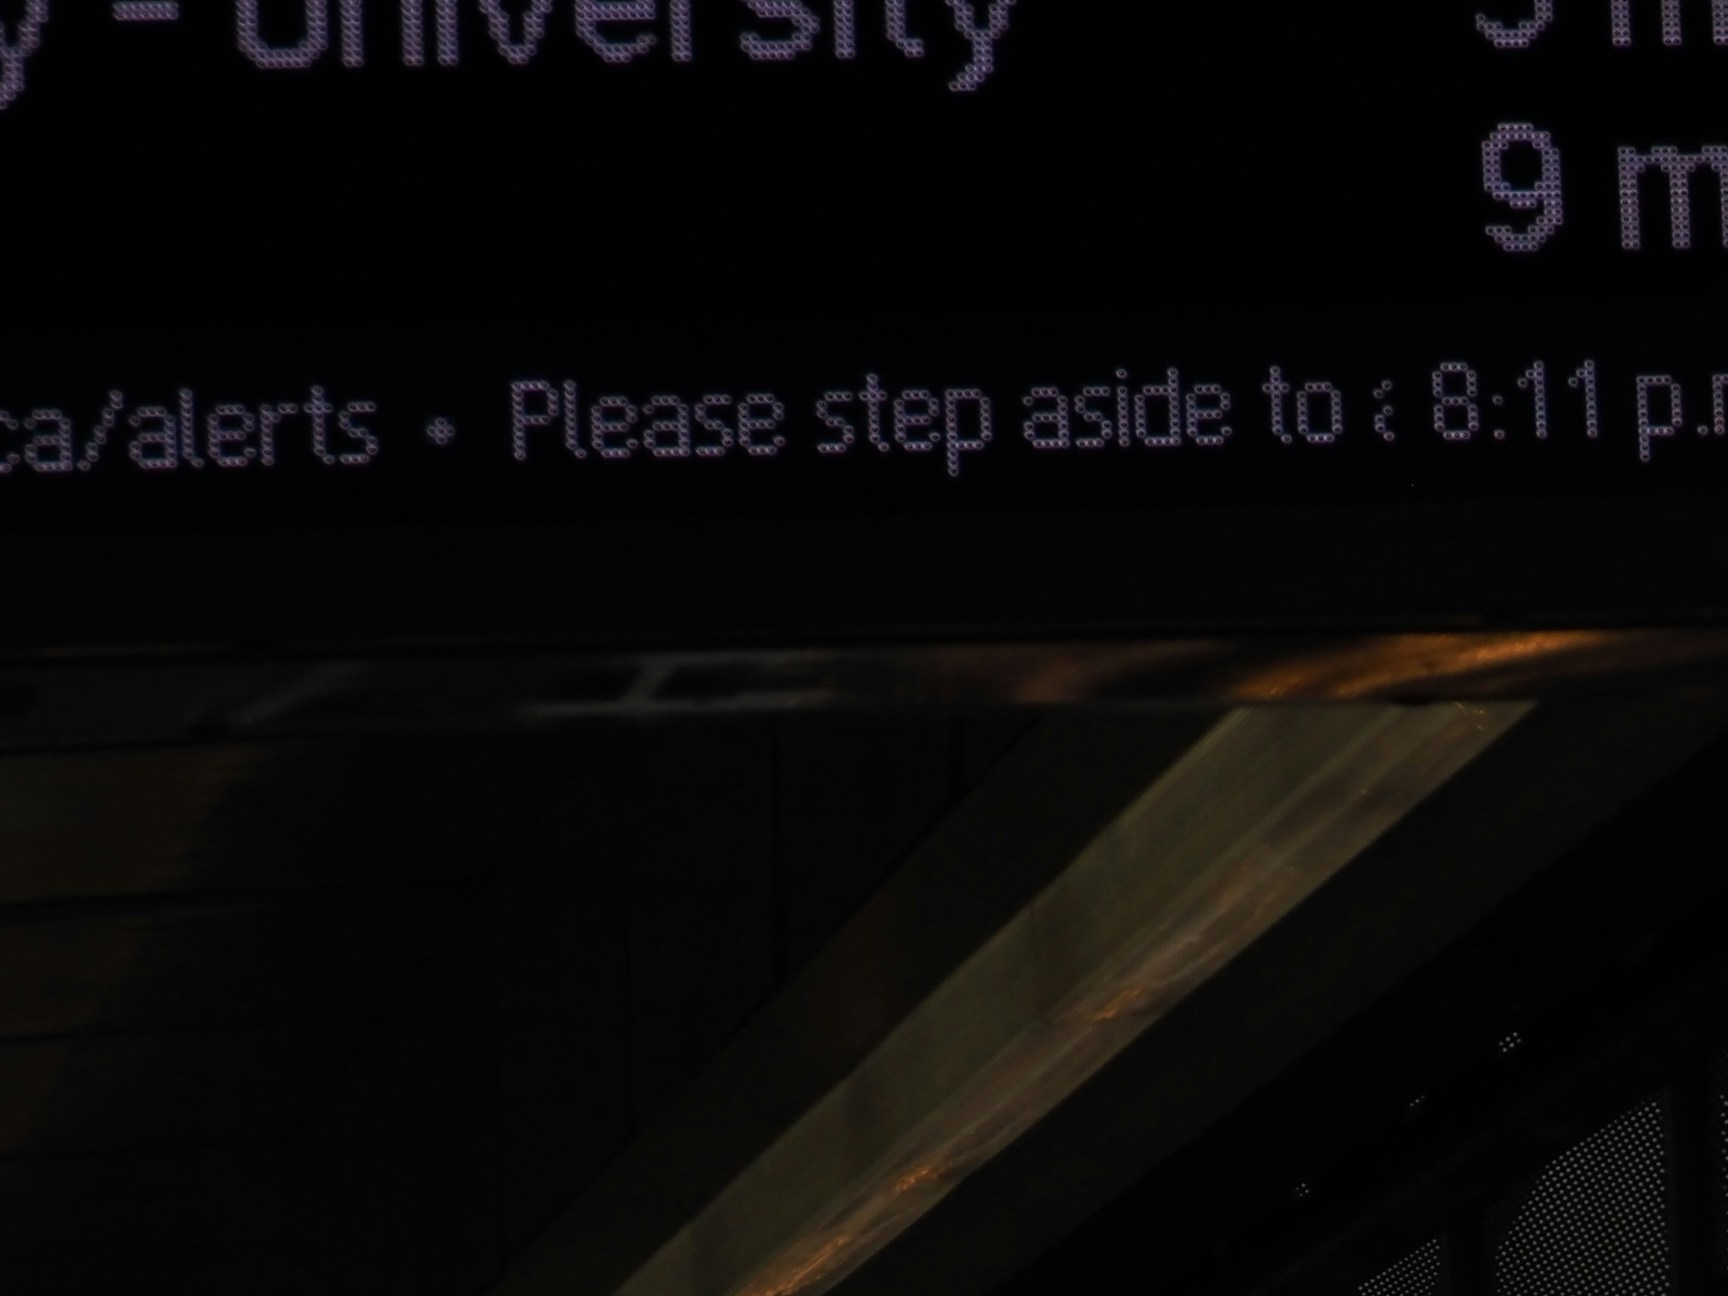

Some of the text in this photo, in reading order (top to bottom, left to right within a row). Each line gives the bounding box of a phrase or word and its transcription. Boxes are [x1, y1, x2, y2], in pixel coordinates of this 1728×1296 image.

[1482, 123, 1563, 251] 9
[511, 381, 784, 459] Please
[817, 374, 992, 476] step
[1023, 368, 1232, 448] aside
[1262, 366, 1343, 443] to
[1432, 360, 1597, 440] 8:11
